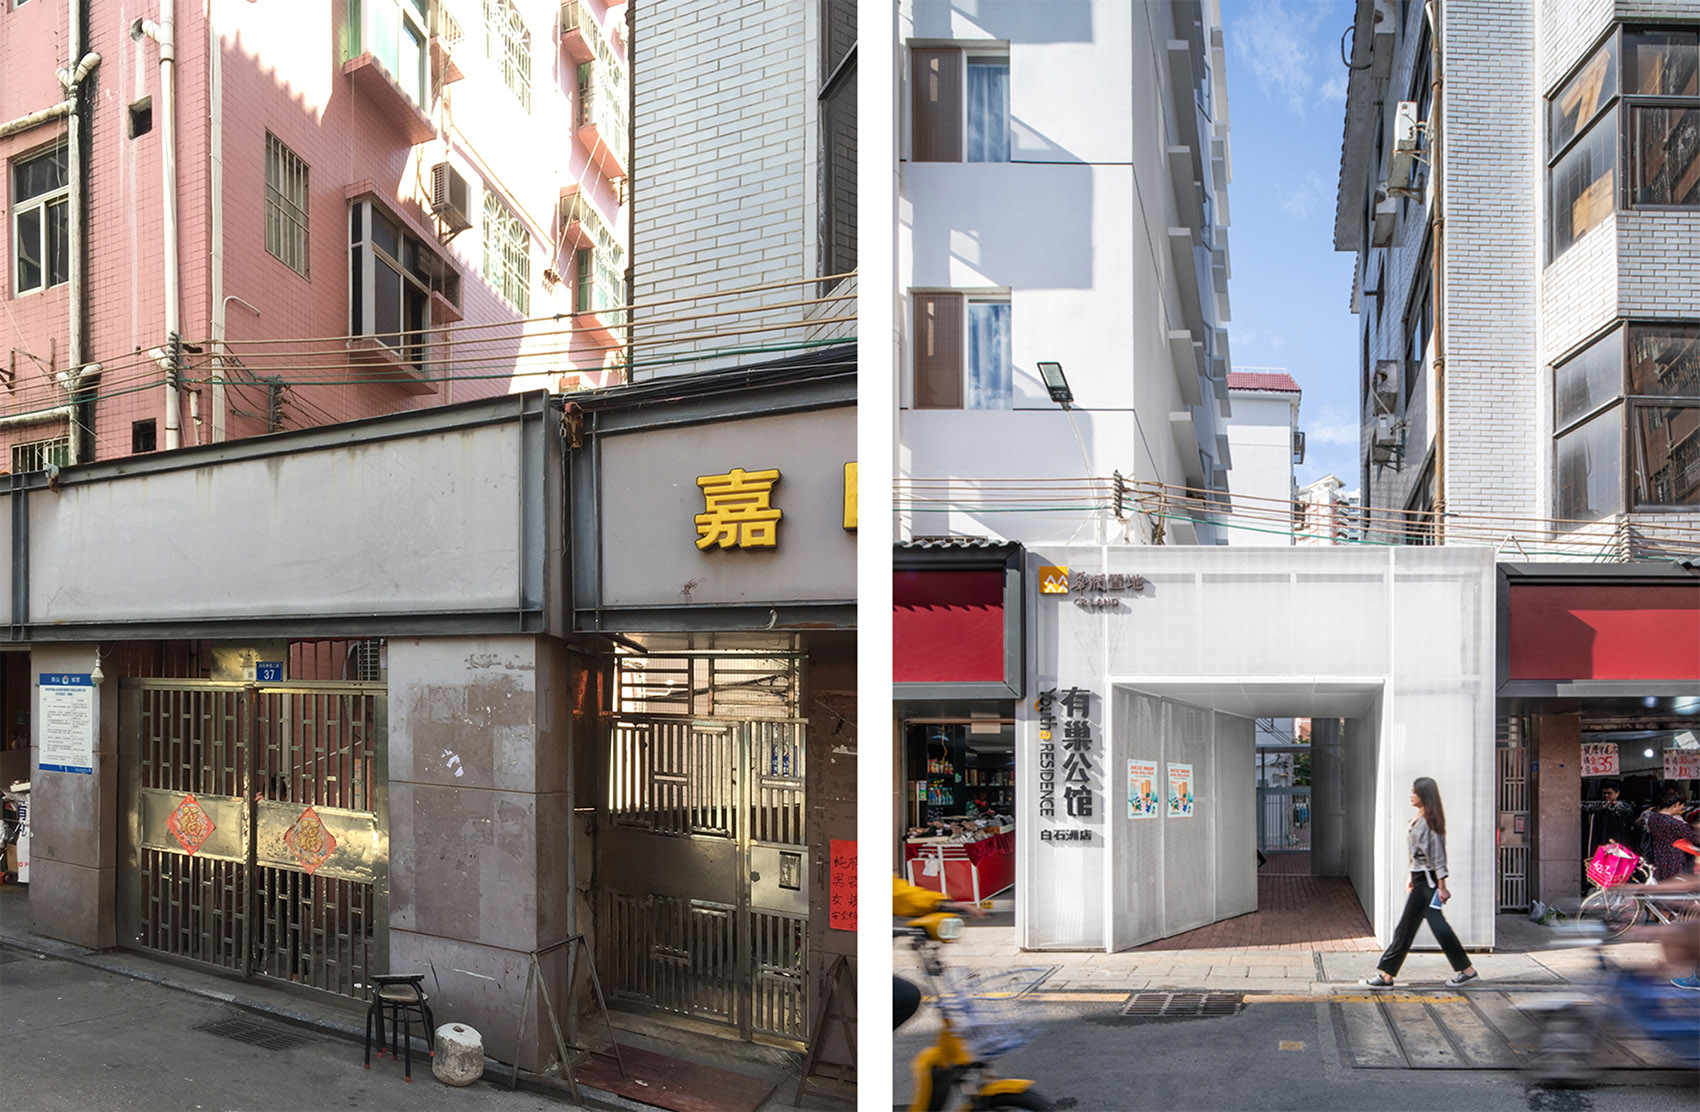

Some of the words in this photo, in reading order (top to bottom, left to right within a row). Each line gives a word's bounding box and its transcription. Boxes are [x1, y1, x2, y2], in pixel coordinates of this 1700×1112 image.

[1073, 598, 1088, 607] CR
[1090, 598, 1119, 607] LAND
[264, 669, 275, 680] 37
[1060, 686, 1092, 817] 有巢公馆
[1040, 743, 1055, 817] RESIDENCE
[1040, 829, 1092, 841] 白石洲店
